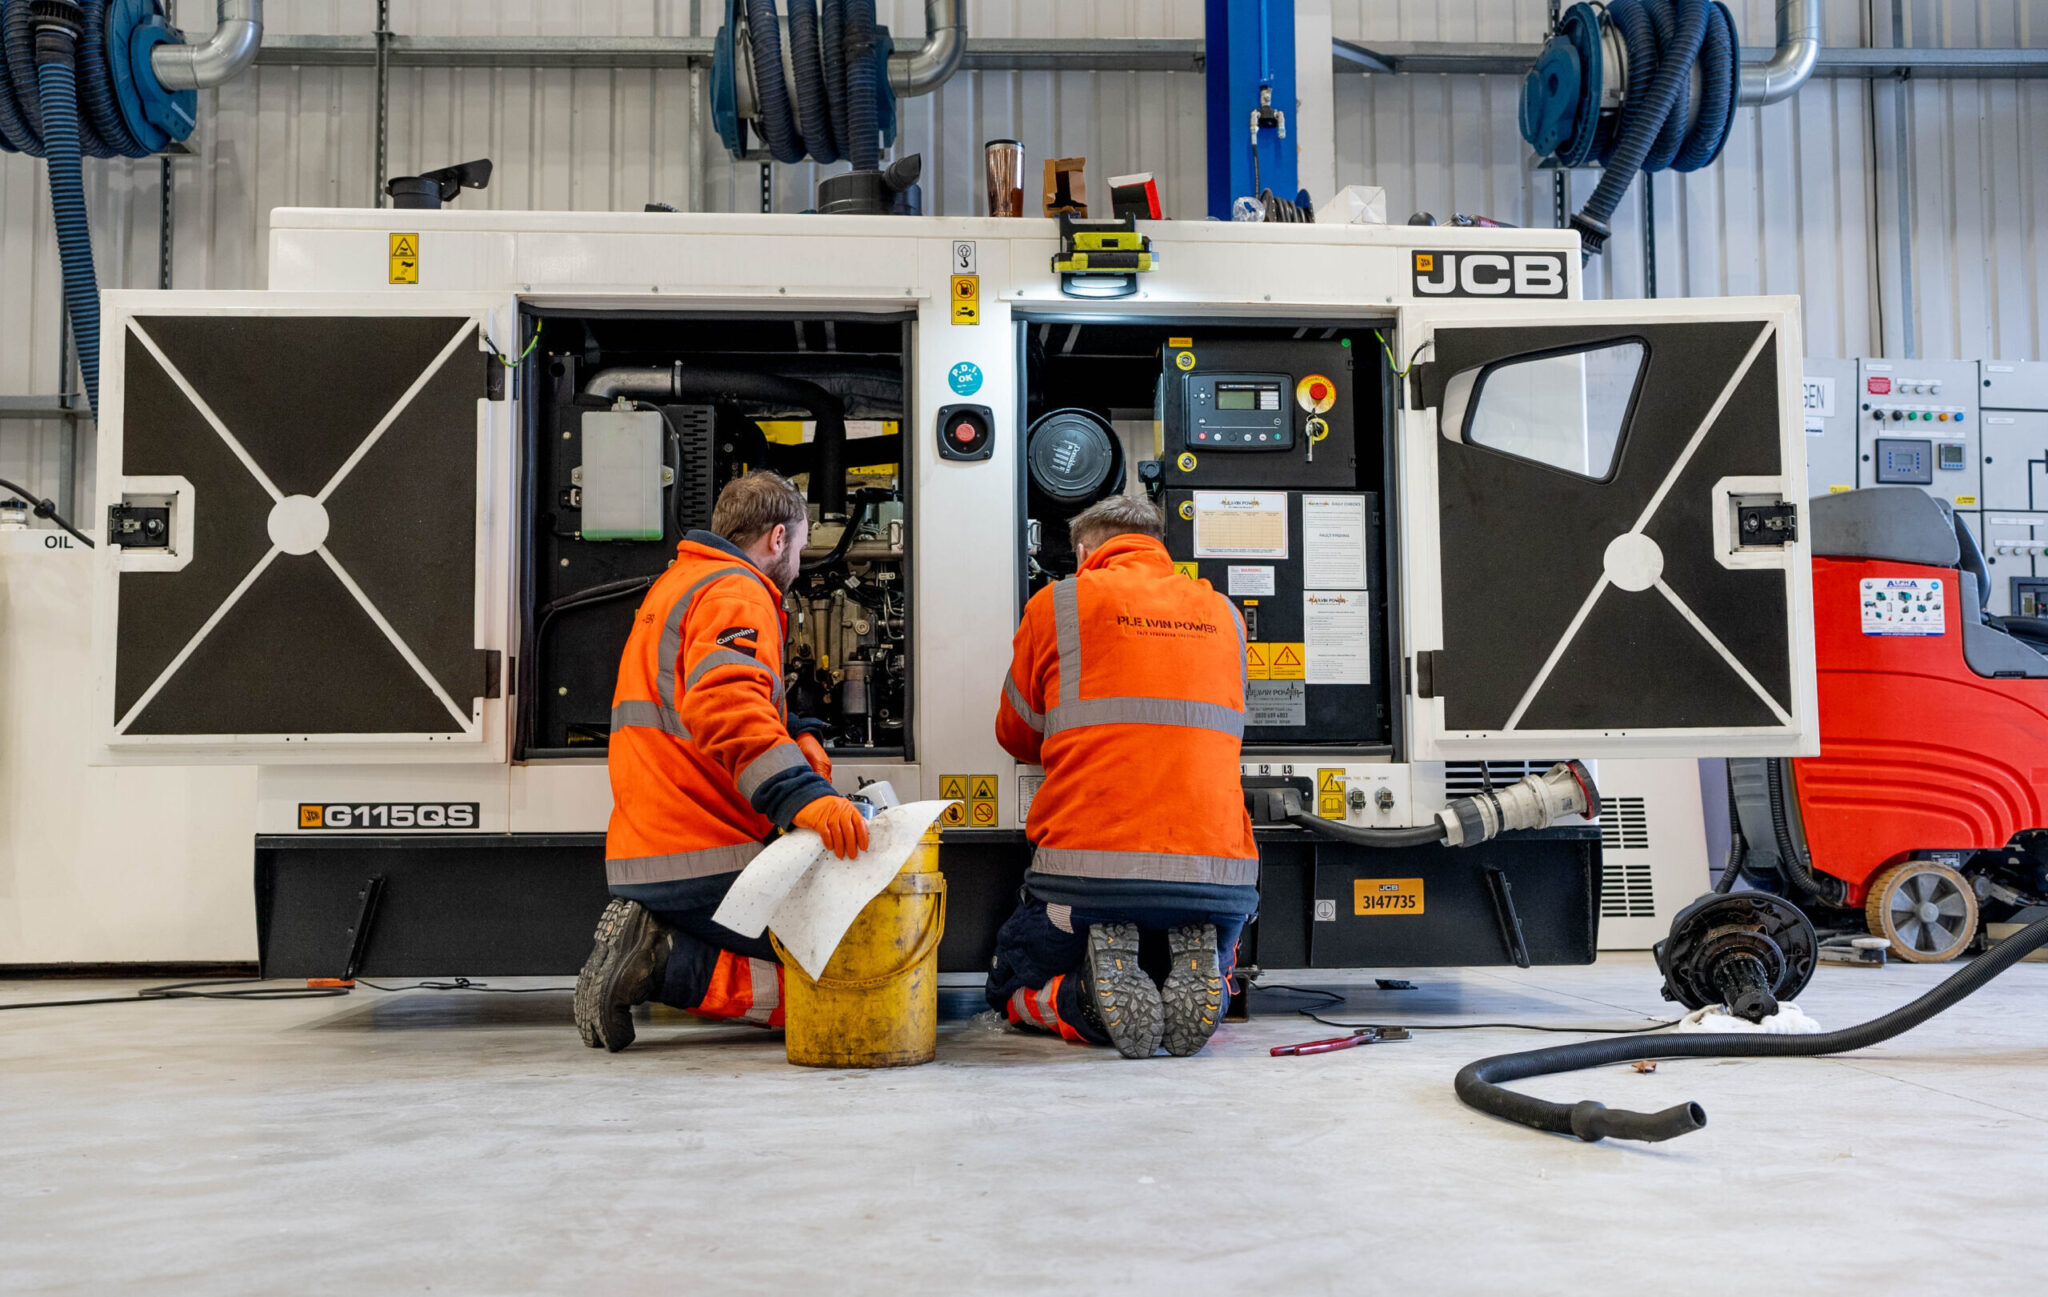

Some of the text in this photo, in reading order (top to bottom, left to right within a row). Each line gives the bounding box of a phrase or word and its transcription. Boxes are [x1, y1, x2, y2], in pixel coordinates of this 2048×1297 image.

[1416, 254, 1564, 295] JCB
[952, 364, 978, 377] P.D.I.
[958, 374, 973, 382] OK
[44, 535, 74, 549] OIL
[1886, 580, 1918, 588] ALPHA
[1174, 621, 1217, 634] POWER
[716, 627, 755, 645] Cummins
[1260, 764, 1269, 775] L2
[1283, 764, 1293, 775] L3
[324, 804, 474, 828] G115QS
[1362, 895, 1416, 909] 3147735
